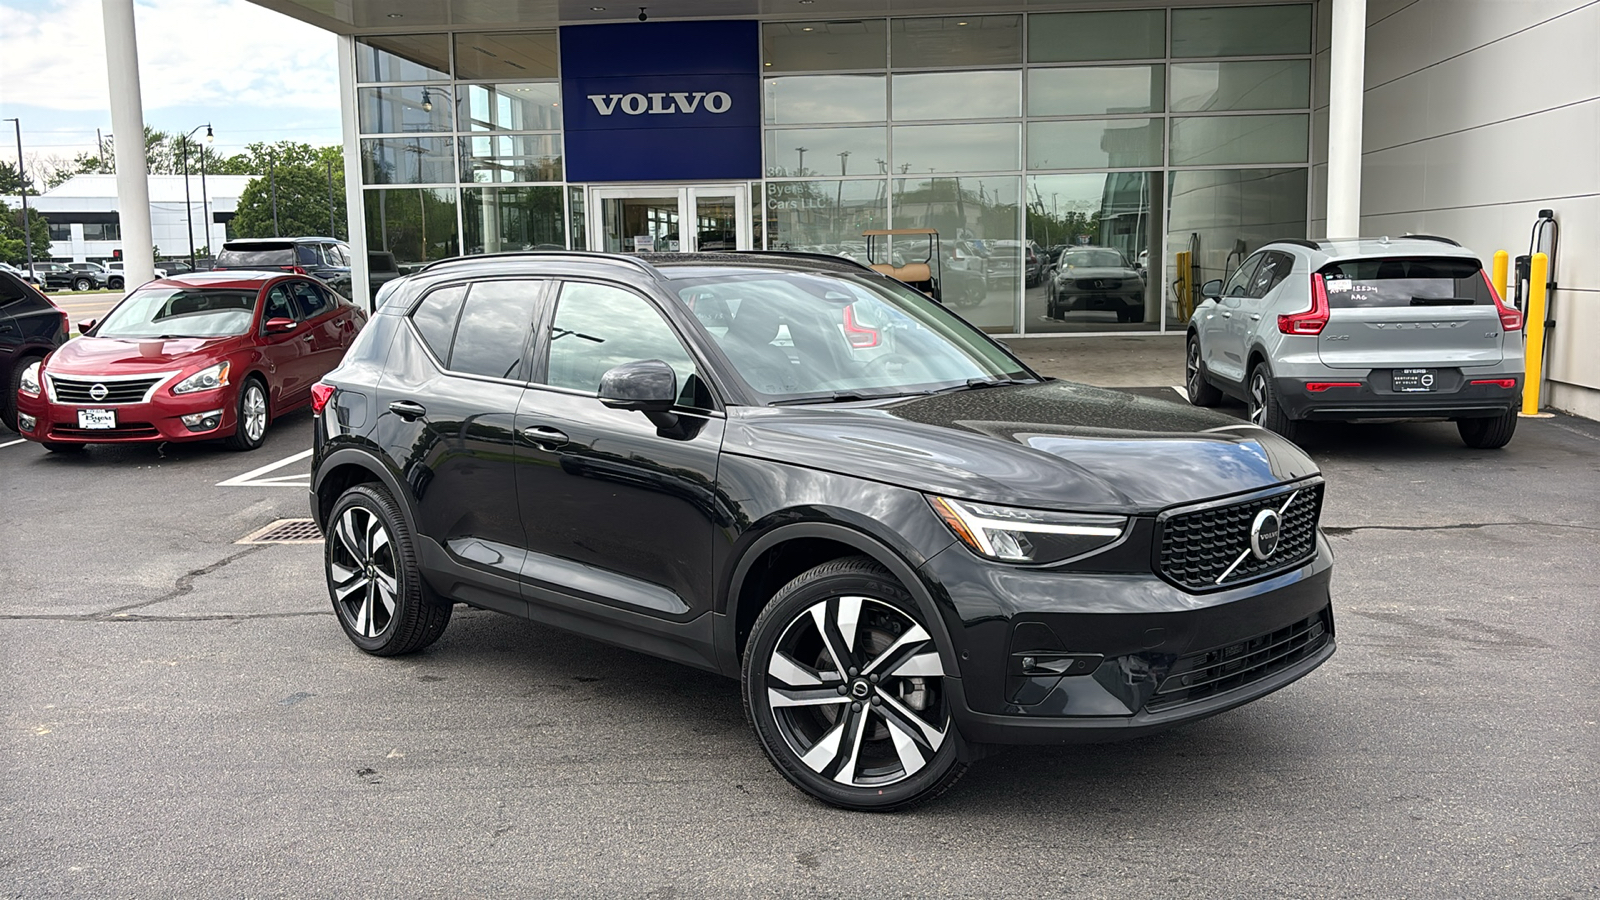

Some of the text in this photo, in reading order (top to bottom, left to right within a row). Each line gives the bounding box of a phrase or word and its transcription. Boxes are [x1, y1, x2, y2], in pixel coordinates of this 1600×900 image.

[587, 91, 732, 116] VOLVO
[767, 183, 804, 197] Byers
[768, 198, 826, 210] Cars LLC
